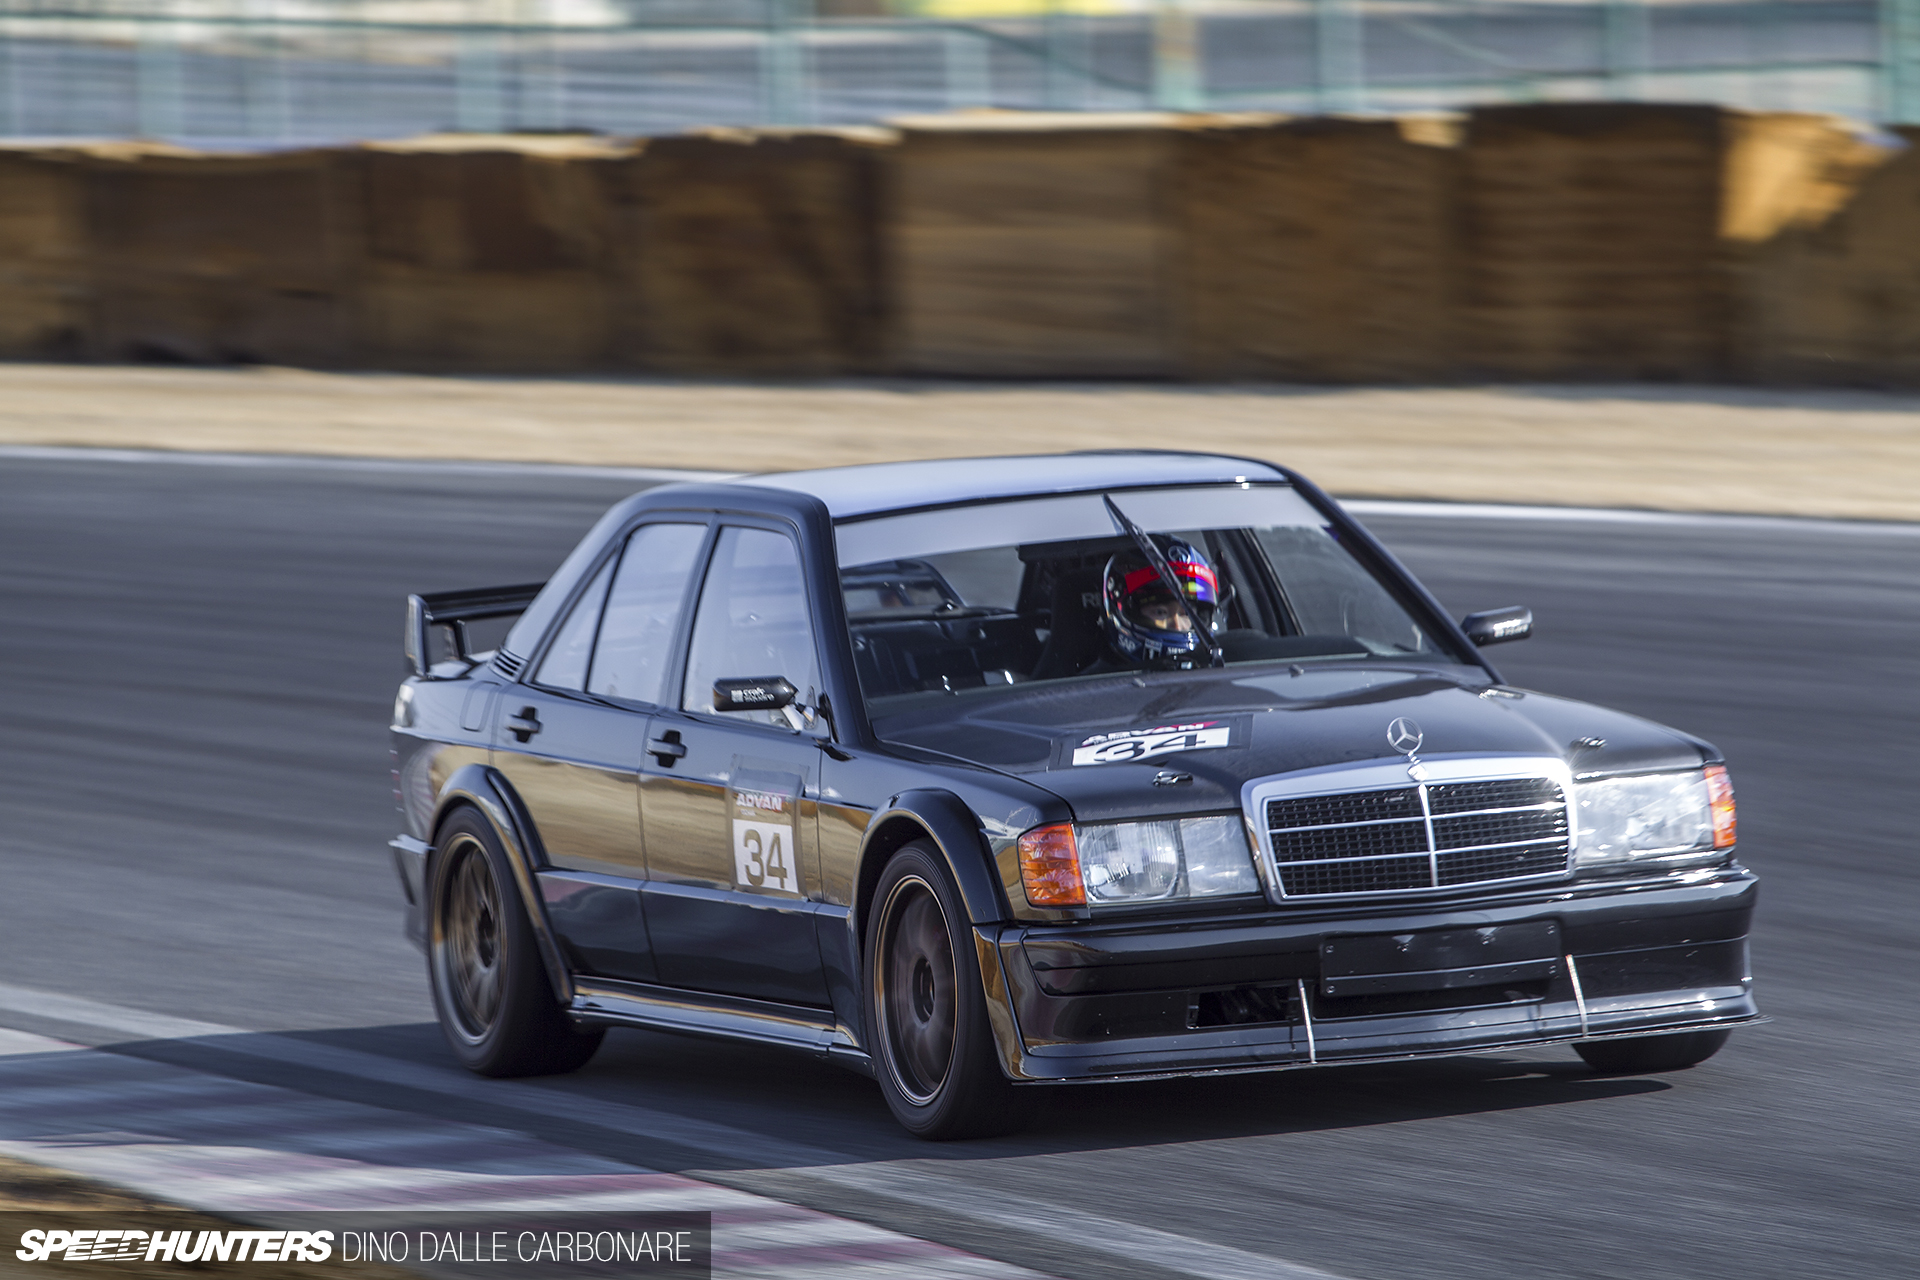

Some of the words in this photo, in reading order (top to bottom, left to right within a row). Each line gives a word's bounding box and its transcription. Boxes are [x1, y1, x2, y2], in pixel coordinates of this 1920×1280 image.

[1117, 633, 1137, 652] SAP
[1094, 734, 1206, 762] 34
[736, 792, 783, 811] ADVAN
[743, 829, 788, 889] 34
